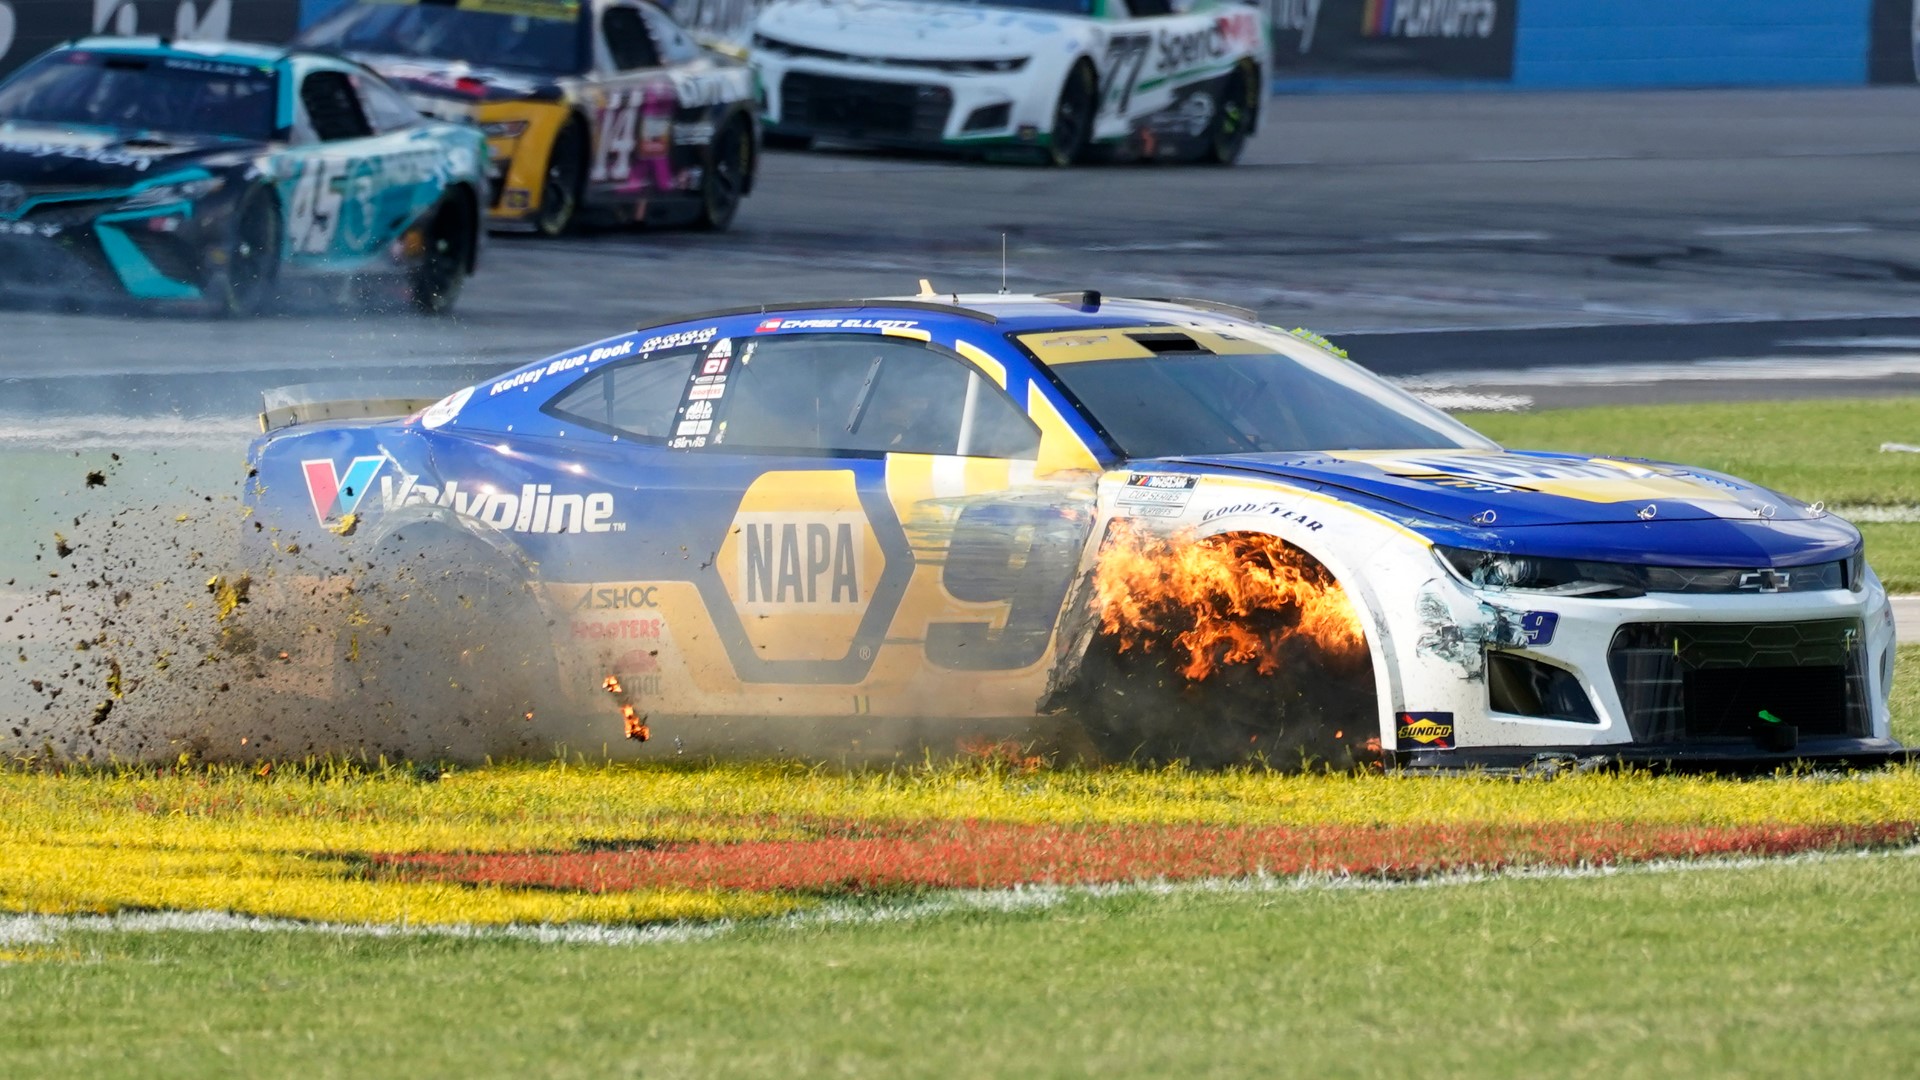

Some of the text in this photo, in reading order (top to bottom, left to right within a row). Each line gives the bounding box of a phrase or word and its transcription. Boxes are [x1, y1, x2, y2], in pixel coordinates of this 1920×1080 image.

[591, 87, 644, 181] 14
[288, 157, 348, 254] 45
[780, 318, 919, 329] CHASE ELLIOTT
[490, 340, 634, 396] Kelley Blue Book
[380, 475, 614, 534] Valvoline
[1129, 490, 1182, 502] CUP SERIES
[1147, 475, 1189, 489] NASCAR
[746, 522, 859, 603] NAPA
[923, 500, 1088, 671] 9
[570, 619, 661, 639] HOOTERS
[1399, 726, 1451, 738] SUNOCO
